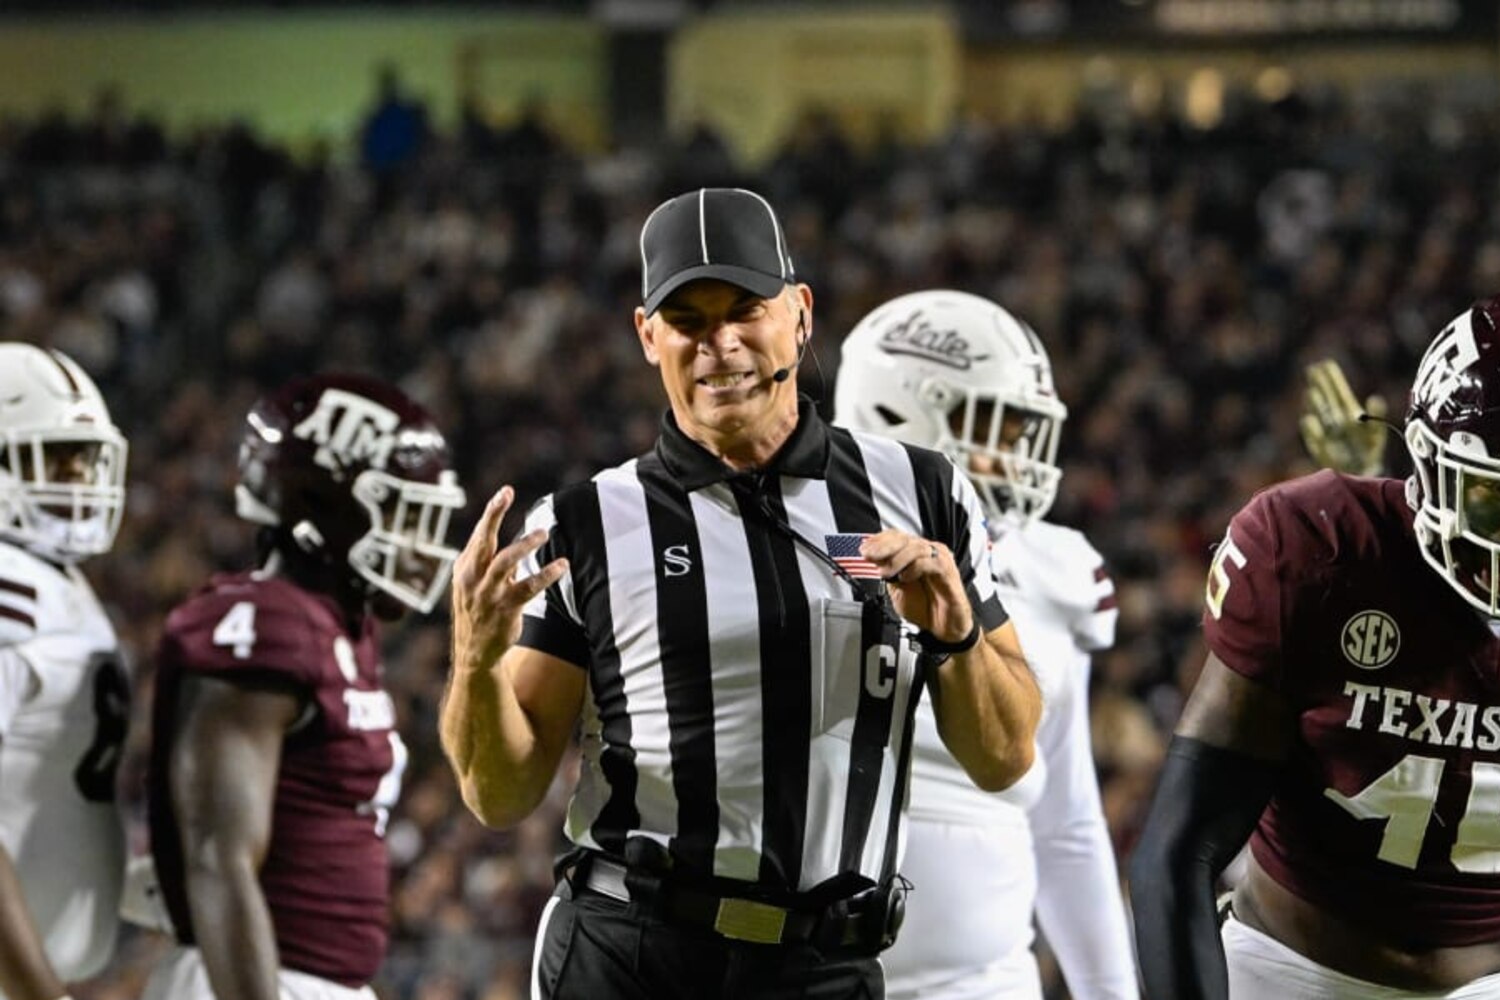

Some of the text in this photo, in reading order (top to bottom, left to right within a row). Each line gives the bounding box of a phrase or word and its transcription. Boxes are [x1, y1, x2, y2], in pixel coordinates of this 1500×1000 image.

[880, 310, 981, 367] State
[213, 601, 257, 659] 4
[1346, 614, 1396, 665] SEC
[865, 644, 897, 699] C
